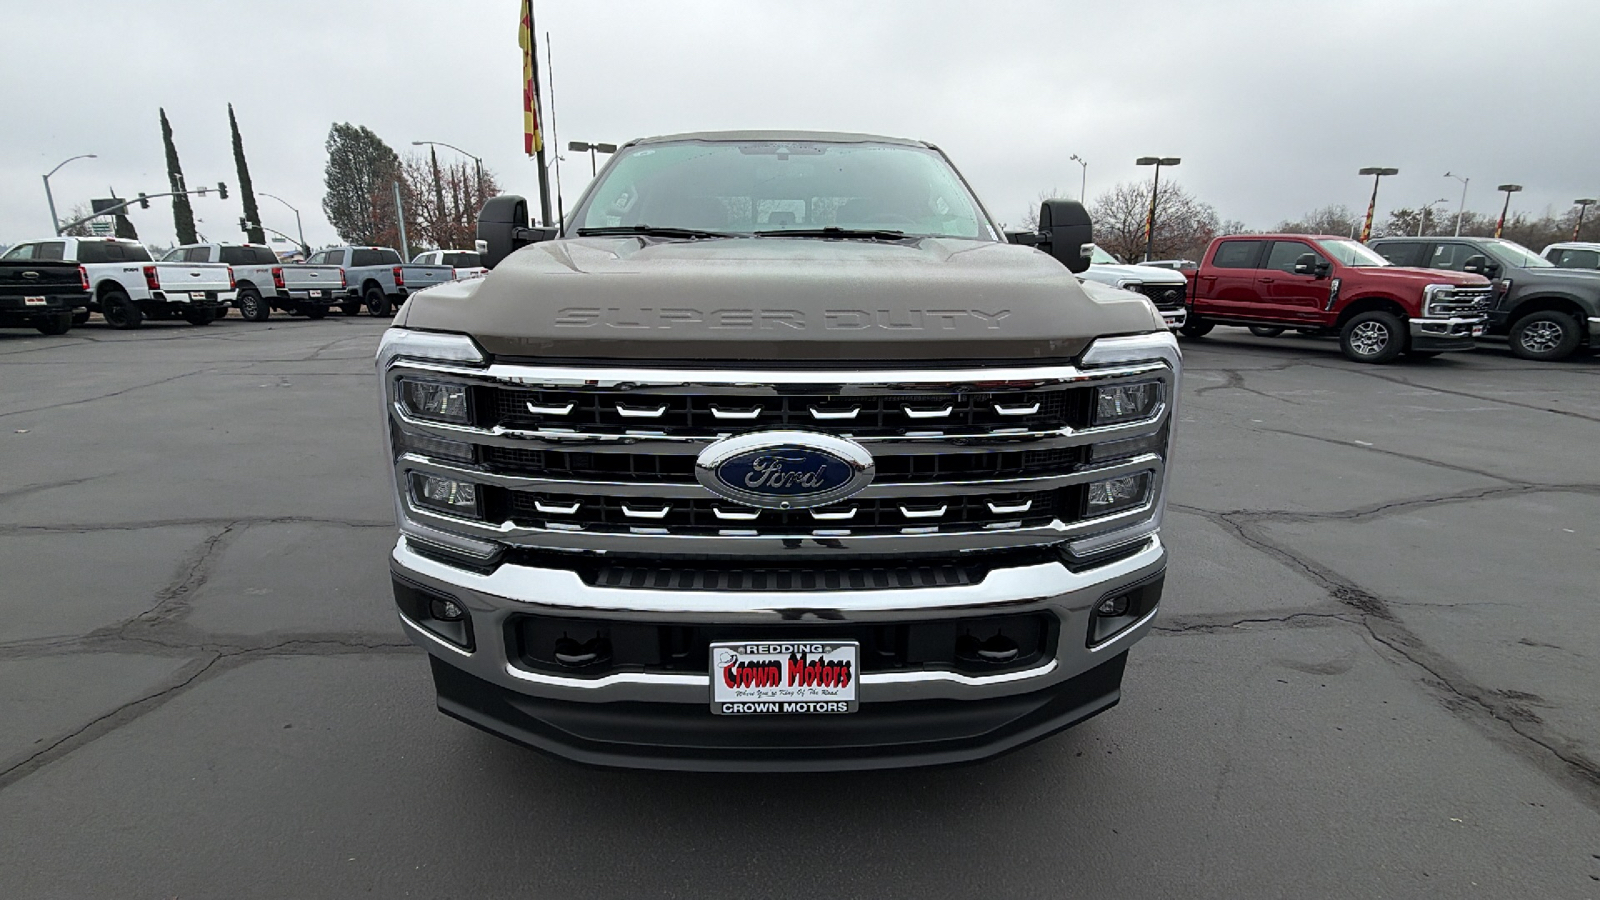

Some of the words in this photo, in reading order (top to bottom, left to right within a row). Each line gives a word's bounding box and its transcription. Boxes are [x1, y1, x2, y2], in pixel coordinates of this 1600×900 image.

[554, 307, 806, 330] SUPER
[825, 309, 1011, 330] DUTY
[744, 455, 827, 488] Ford
[746, 644, 823, 654] REDDING
[723, 655, 782, 689] Crown
[787, 653, 852, 688] Motors
[779, 689, 794, 697] King
[796, 688, 805, 697] Of
[722, 702, 779, 713] CROWN
[783, 702, 848, 712] MOTORS
